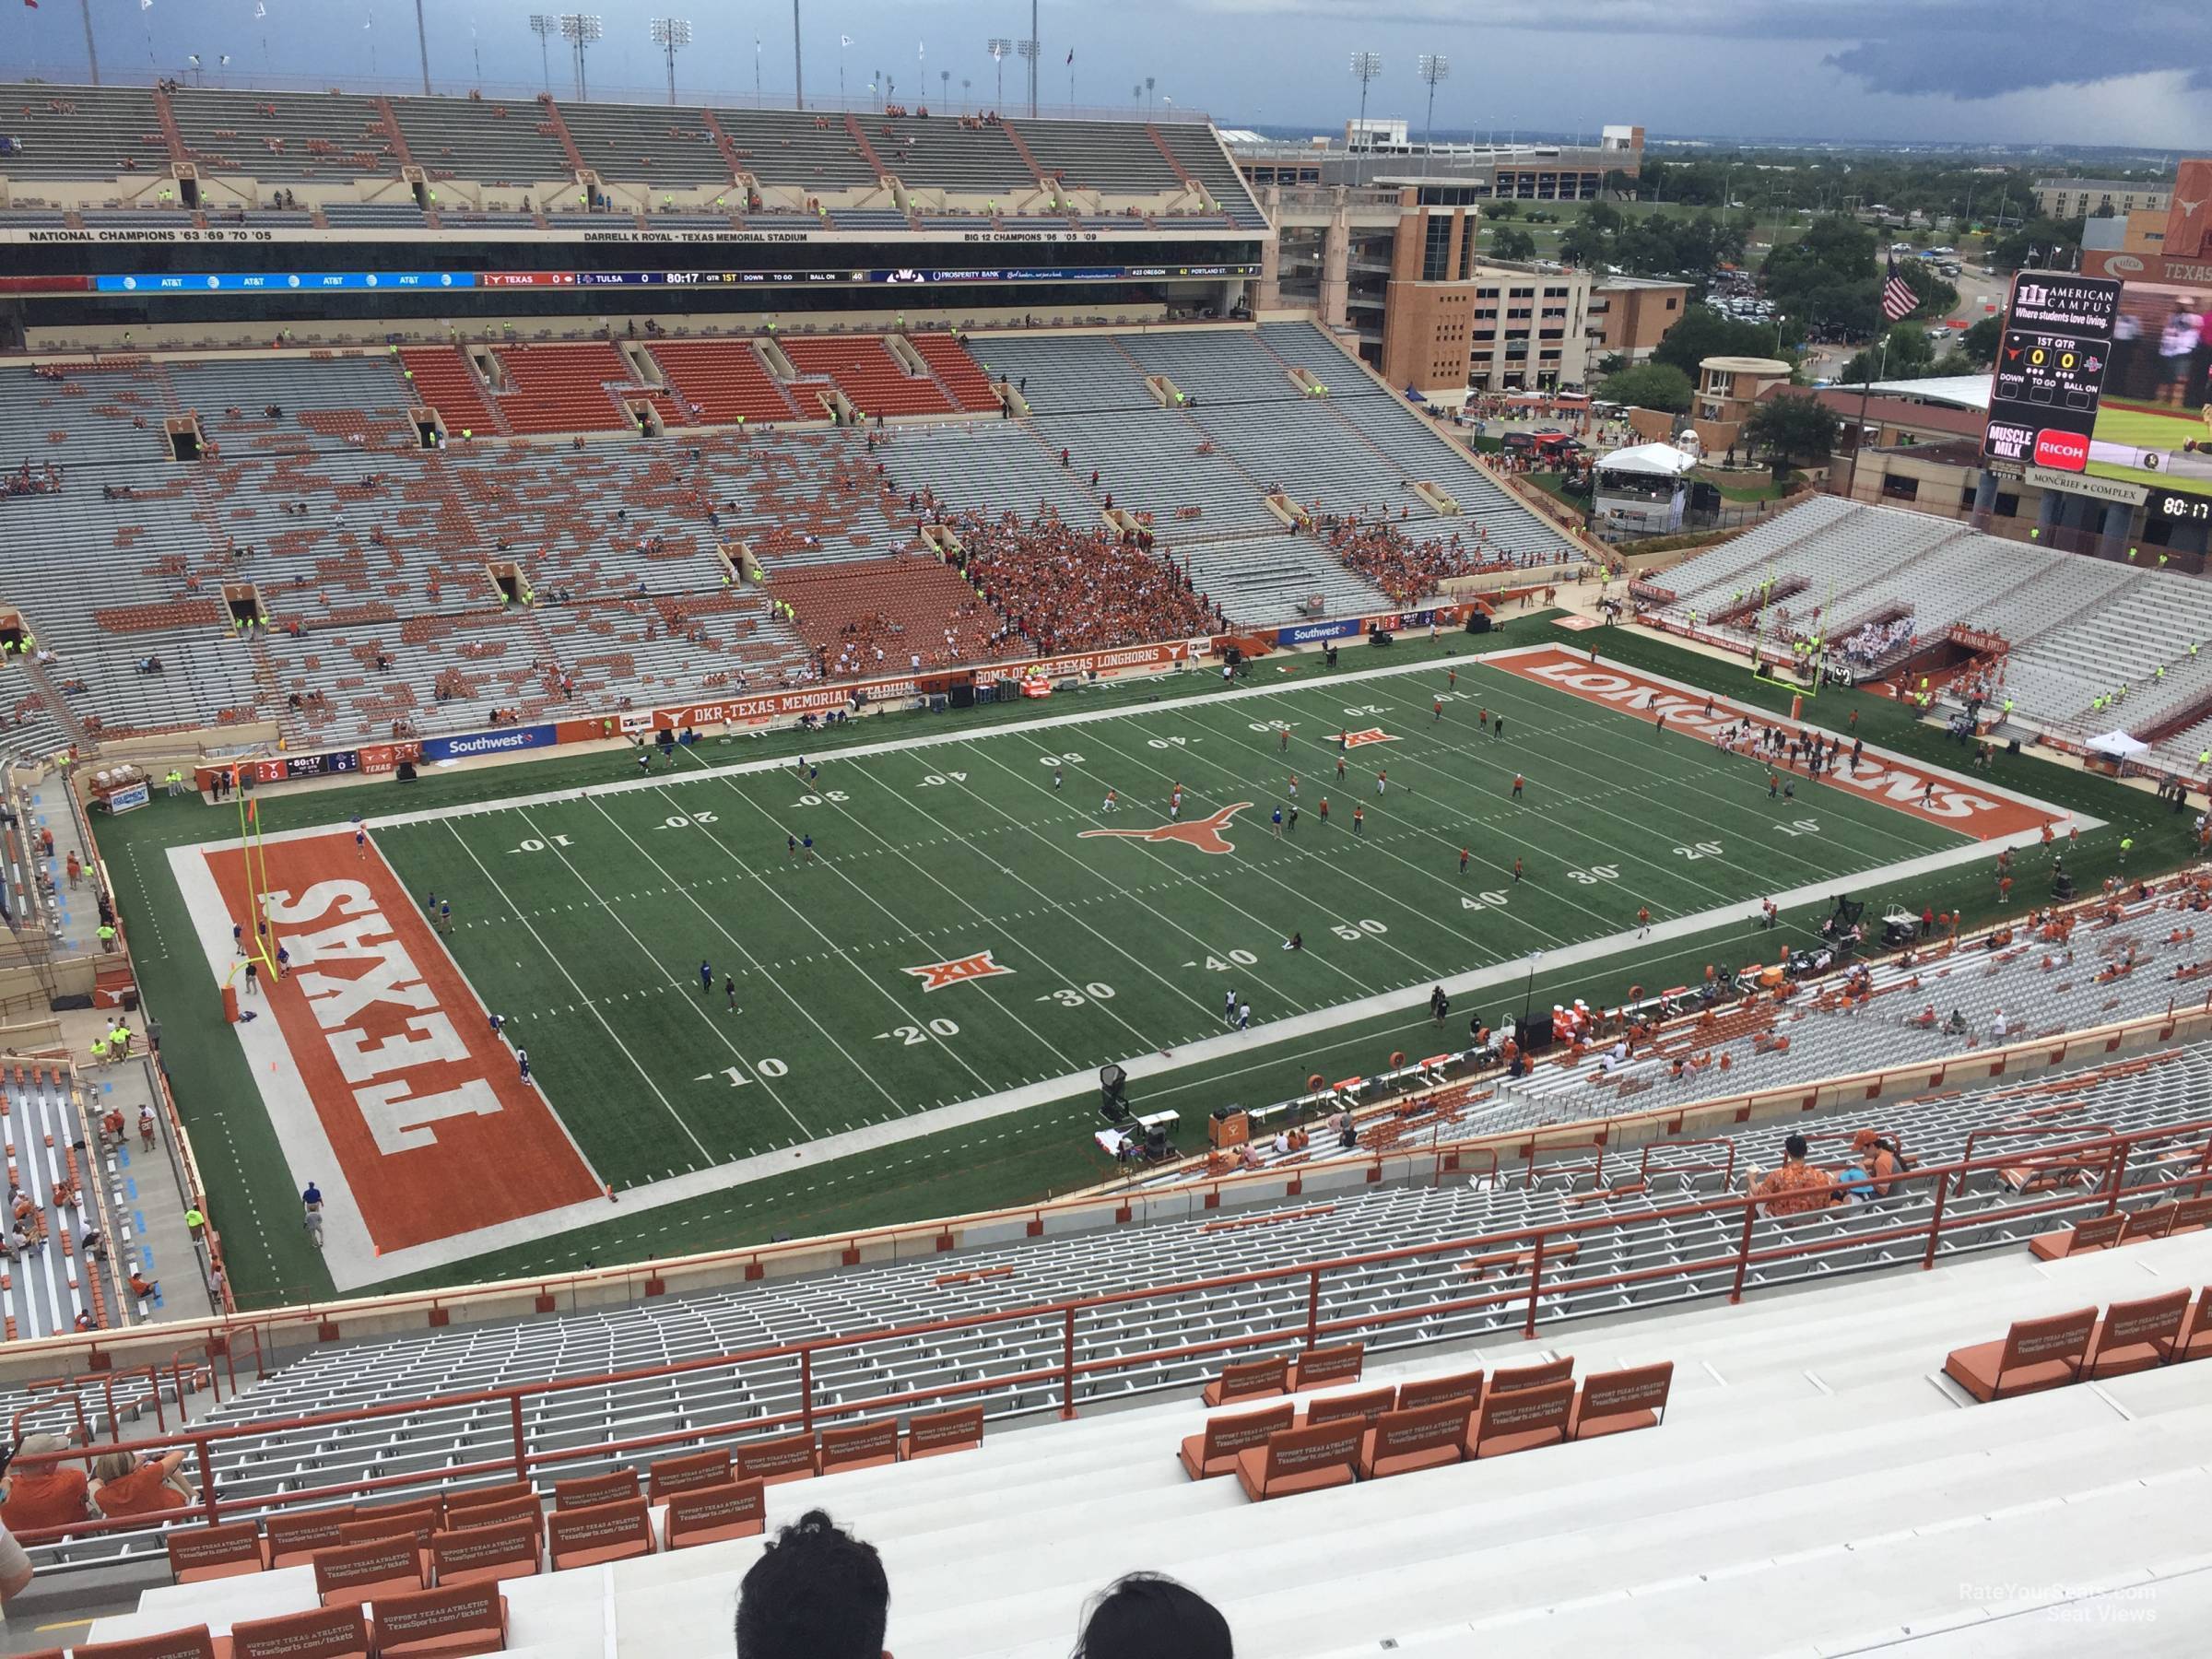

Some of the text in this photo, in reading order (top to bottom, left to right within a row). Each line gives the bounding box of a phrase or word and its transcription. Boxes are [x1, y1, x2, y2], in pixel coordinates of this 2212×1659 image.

[29, 231, 94, 241] NATIONAL
[100, 231, 175, 241] CHAMPIONS
[180, 231, 199, 241] '63
[229, 231, 248, 241] '70
[253, 230, 271, 241] '05
[584, 232, 629, 241] DARRELL
[631, 232, 639, 241] K
[641, 232, 672, 241] ROYAL
[682, 232, 713, 241] TEXAS
[716, 232, 764, 241] MEMORIAL
[768, 232, 807, 241] STADIUM
[994, 233, 1041, 241] CHAMPIONS
[161, 278, 182, 287] AT&T
[244, 277, 264, 286] AT&T
[324, 277, 343, 286] AT&T
[399, 276, 418, 284] AT&T
[667, 274, 699, 283] 80:17
[723, 274, 736, 282] 1ST
[2049, 287, 2114, 302] AMERICAN
[2047, 298, 2112, 313] CAMPUS
[2016, 307, 2108, 328] Where students love living.
[2038, 336, 2075, 349] 1ST QTR
[2032, 349, 2043, 364] 0
[2062, 353, 2074, 368] 0
[2000, 373, 2024, 382] DOWN
[2064, 382, 2098, 393] BALL ON
[1990, 426, 2033, 446] MUSCLE
[1994, 441, 2022, 458] MILK
[2040, 442, 2084, 458] RICOH
[2034, 474, 2080, 489] MONCRIEF
[2090, 484, 2136, 500] COMPLEX
[2163, 498, 2208, 519] 80:17
[1294, 626, 1340, 640] Southwest
[976, 669, 1007, 684] HOME
[1056, 658, 1093, 672] TEXAS
[1098, 649, 1159, 667] LONGHORNS
[694, 700, 775, 723] DKR-TEXAS
[782, 690, 849, 710] MEMORIAL
[1343, 704, 1385, 717] 20
[449, 734, 524, 754] Southwest
[1147, 735, 1186, 749] 40
[1040, 752, 1086, 767] 50
[365, 763, 391, 772] TEXAS
[924, 771, 968, 786] 40
[803, 790, 851, 806] 30
[665, 810, 720, 829] 20
[1774, 819, 1820, 837] 10
[520, 833, 575, 853] 10
[1673, 841, 1724, 861] 20
[1567, 865, 1620, 885] 30
[1460, 890, 1509, 912] 40
[1330, 919, 1388, 941] 50
[1203, 949, 1258, 971] 40
[1054, 982, 1115, 1007] 30
[258, 878, 503, 1156] TEXAS
[894, 1018, 960, 1045] 20
[720, 1058, 789, 1087] 10
[586, 1522, 606, 1530] TEXAS
[353, 1559, 374, 1568] TEXAS
[383, 1600, 488, 1622] SUPPORT TEXAS ATHLETICS
[247, 1624, 354, 1649] SUPPORT TEXAS ATHLETICS
